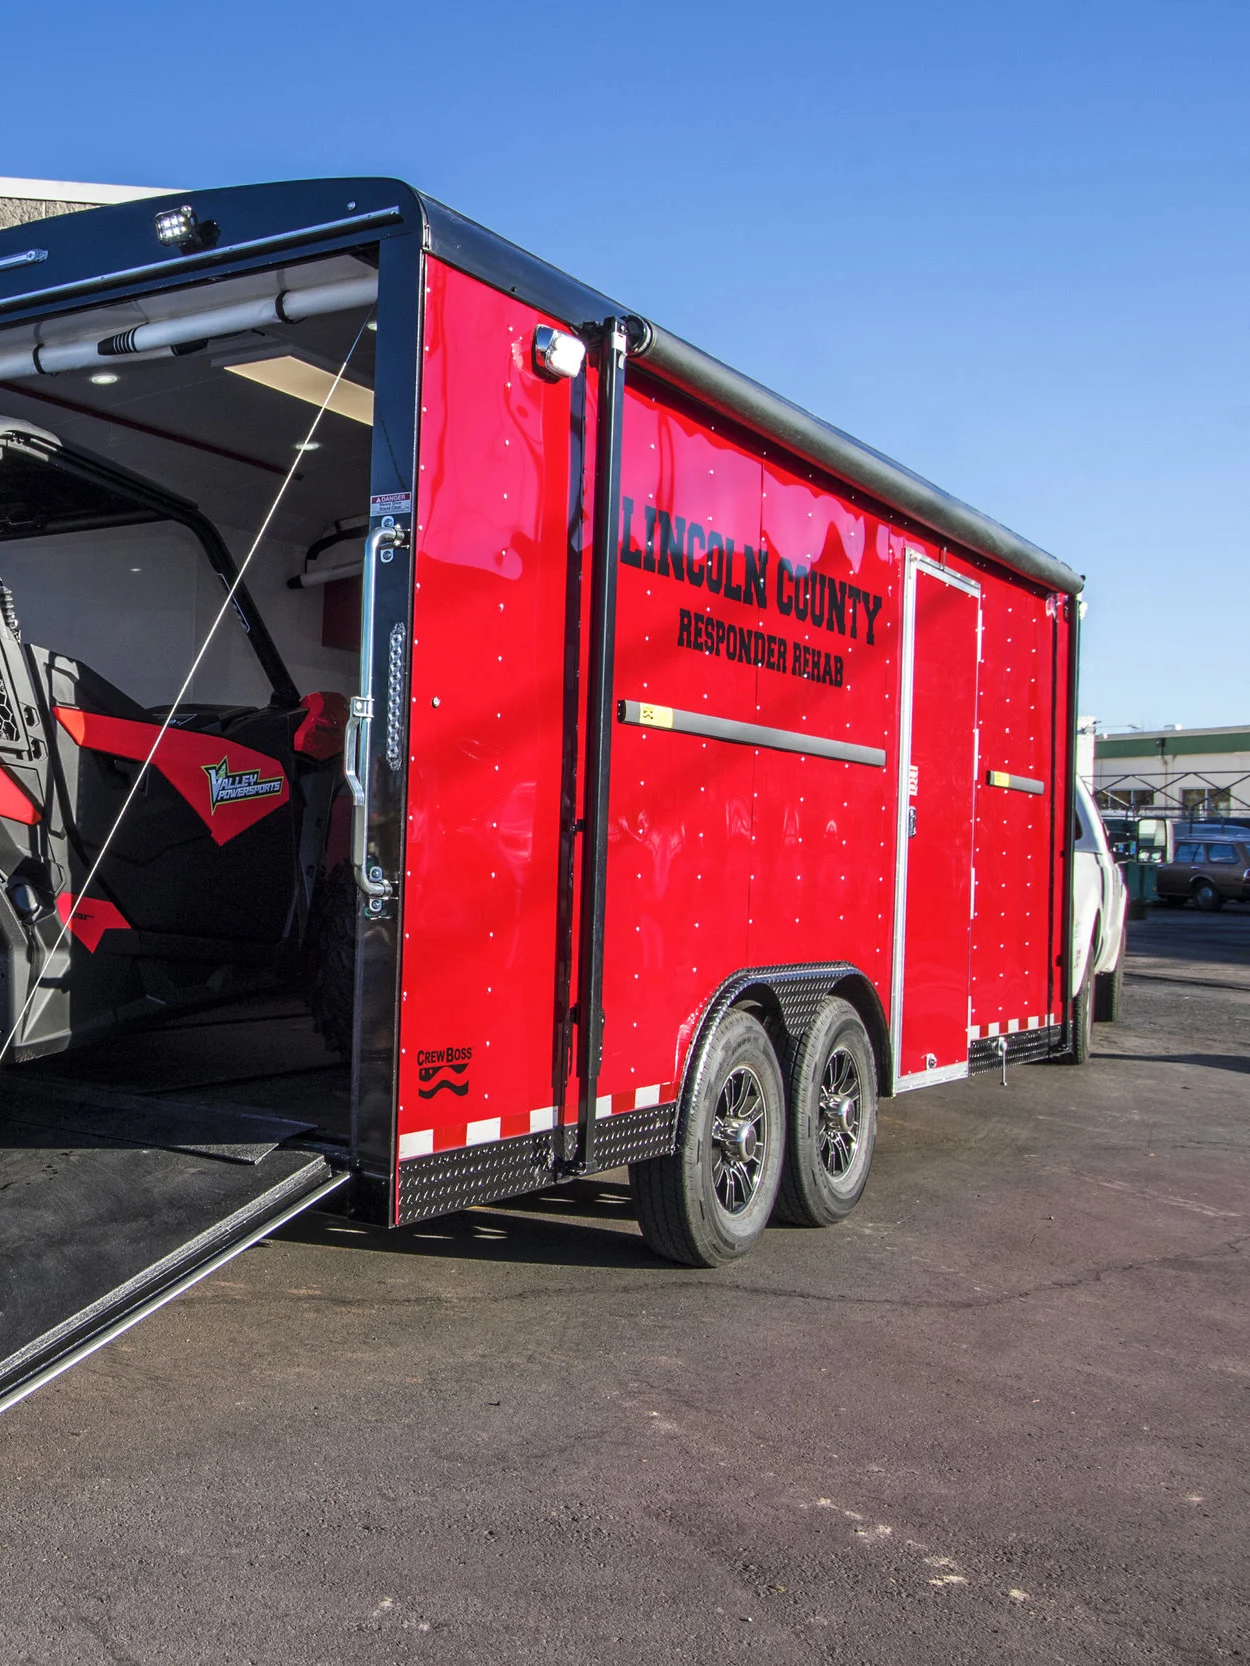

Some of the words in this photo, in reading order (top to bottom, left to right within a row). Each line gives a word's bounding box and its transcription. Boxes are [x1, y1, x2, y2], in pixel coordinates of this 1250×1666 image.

[620, 496, 768, 609] LINCOLN
[776, 558, 882, 645] COUNTY
[677, 608, 787, 673] RESPONDER
[791, 642, 844, 688] REHAB
[209, 762, 258, 803] VALLEY
[217, 781, 281, 801] POWERSPORTS
[417, 1049, 445, 1066] CREW
[446, 1047, 472, 1063] BOSS
